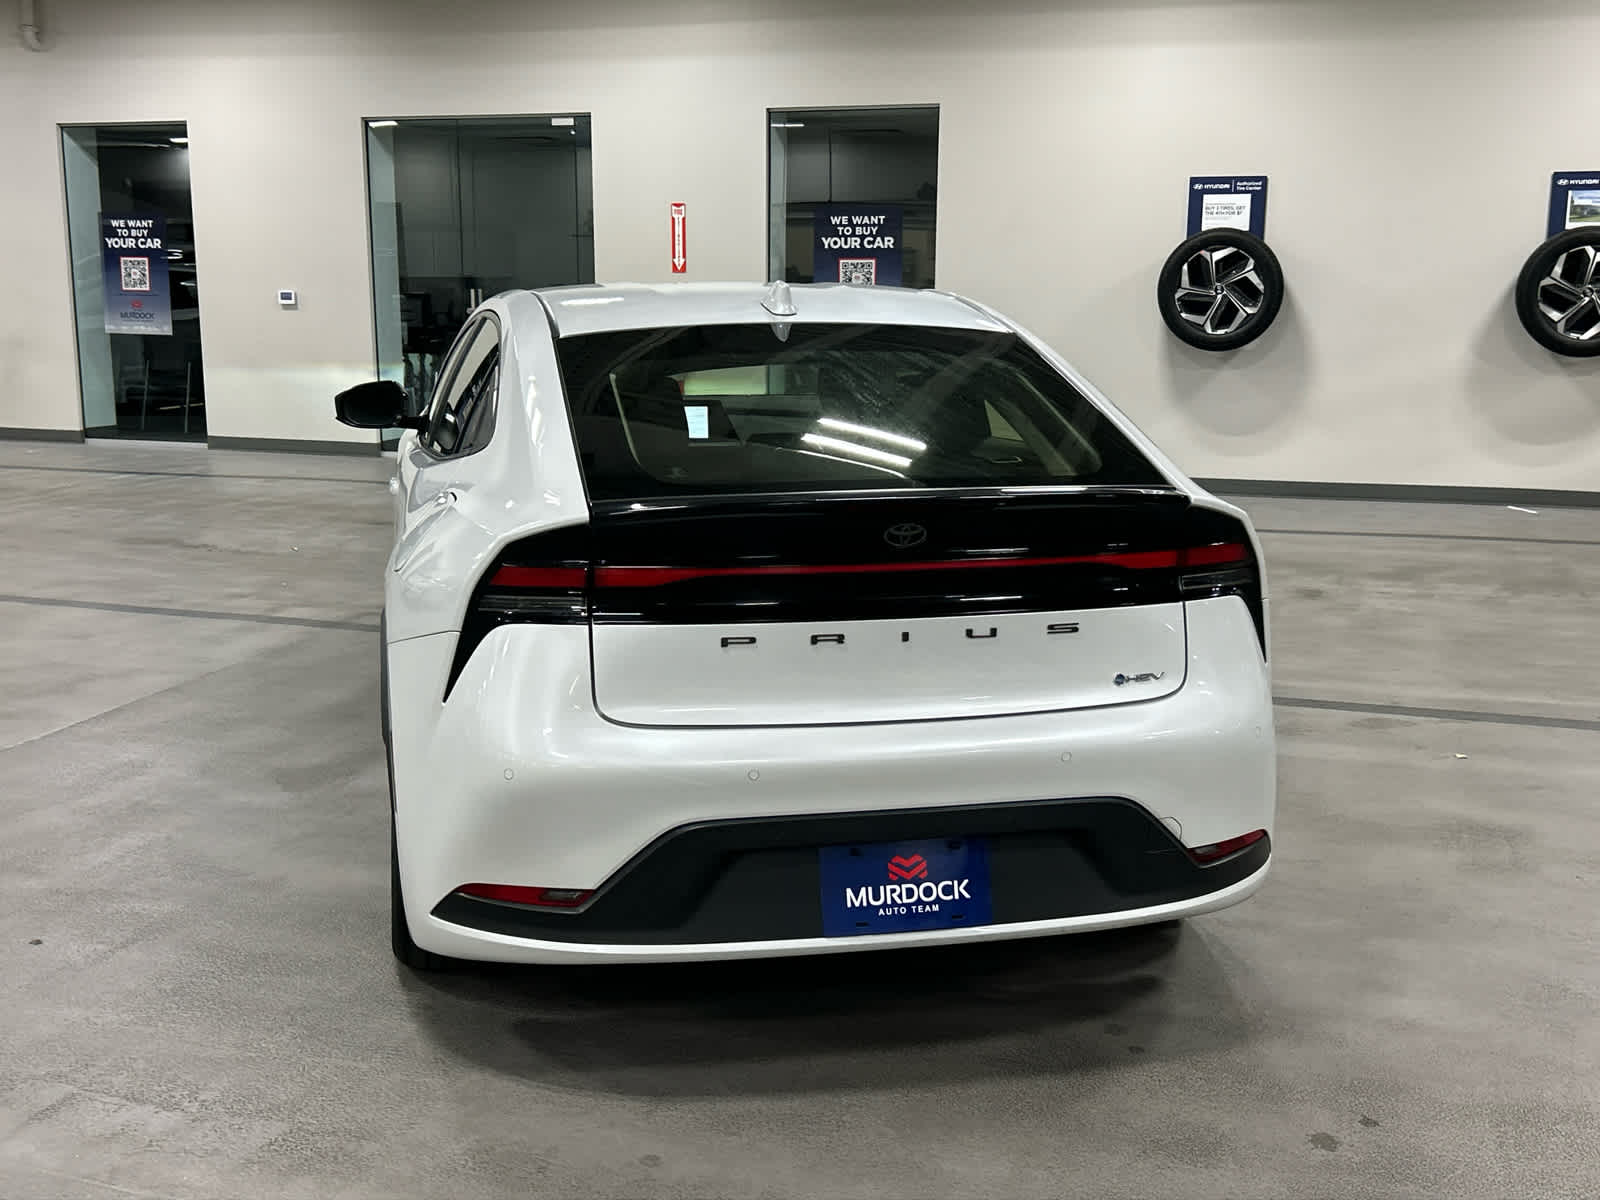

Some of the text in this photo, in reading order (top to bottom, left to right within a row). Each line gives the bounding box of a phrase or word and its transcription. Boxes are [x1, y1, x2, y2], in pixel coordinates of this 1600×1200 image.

[110, 219, 154, 228] WE WANT
[830, 215, 886, 225] WE WANT
[116, 228, 148, 237] TO BUY
[837, 226, 878, 235] TO BUY
[104, 237, 162, 249] YOUR CAR
[821, 237, 894, 249] YOUR CAR
[120, 312, 155, 320] MURDOCK
[721, 622, 1080, 648] PRIUS
[845, 879, 971, 908] MURDOCK
[878, 904, 939, 916] AUTO TEAM
